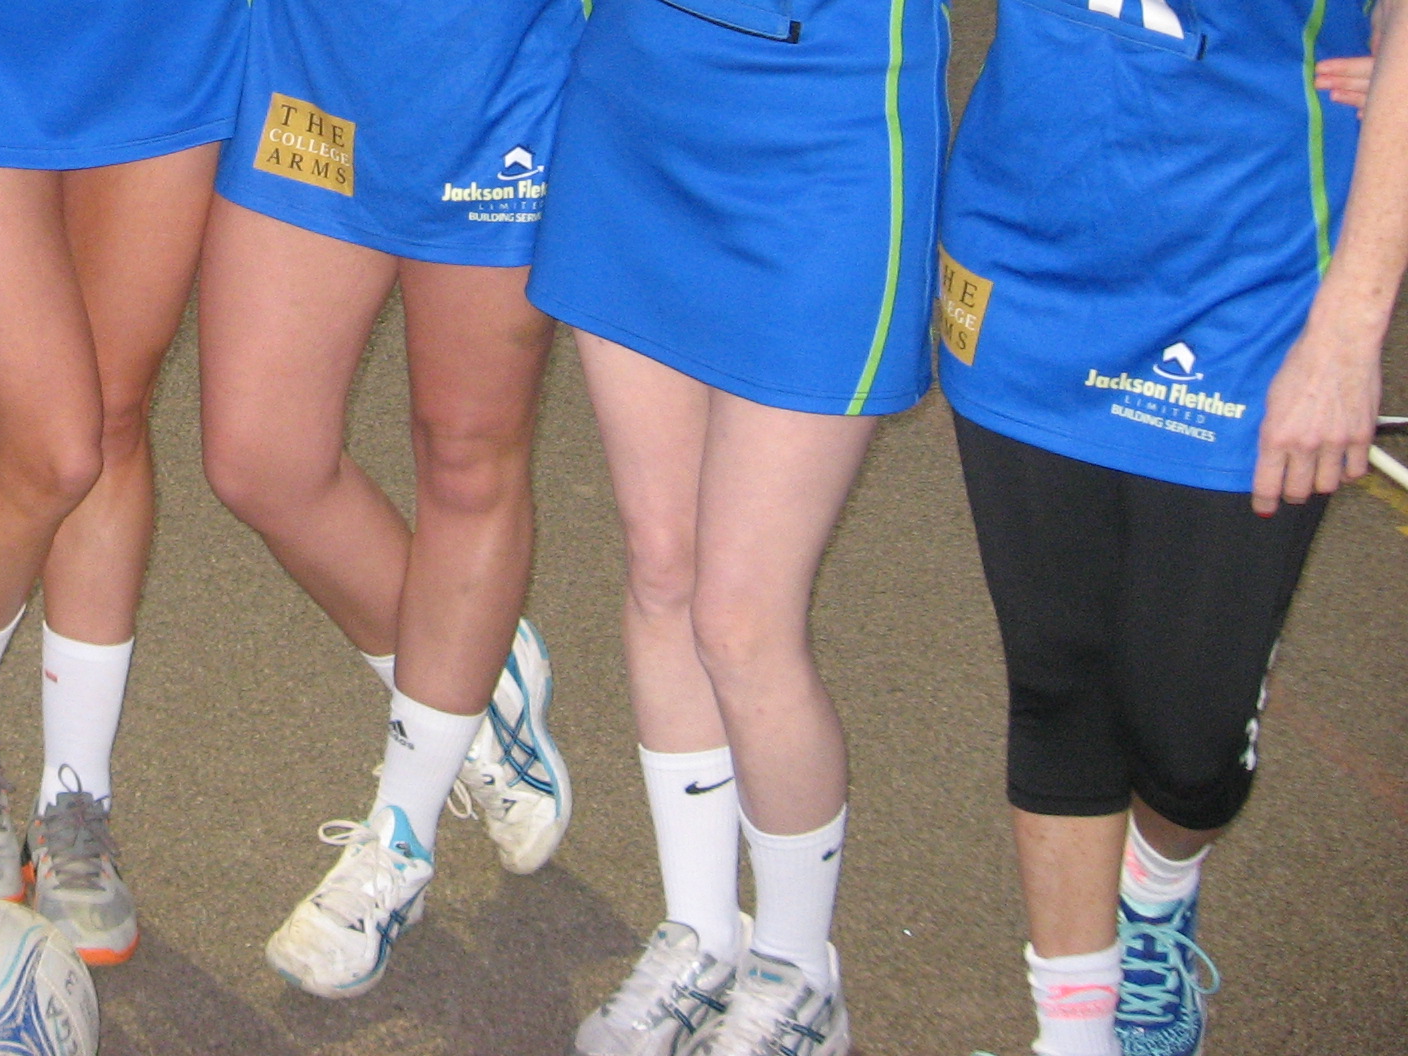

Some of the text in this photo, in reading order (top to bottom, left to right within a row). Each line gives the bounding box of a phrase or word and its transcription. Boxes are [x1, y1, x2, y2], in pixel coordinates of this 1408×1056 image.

[280, 104, 345, 147] THE
[266, 147, 348, 185] ARMS
[269, 128, 351, 166] COLLEGE
[442, 181, 514, 202] Jackson
[468, 211, 514, 222] BUILDING
[942, 264, 978, 308] HE
[1085, 369, 1247, 419] Jackson Fletcher
[1124, 395, 1207, 424] LIMITED
[1111, 403, 1217, 443] BUILDING SERVICES
